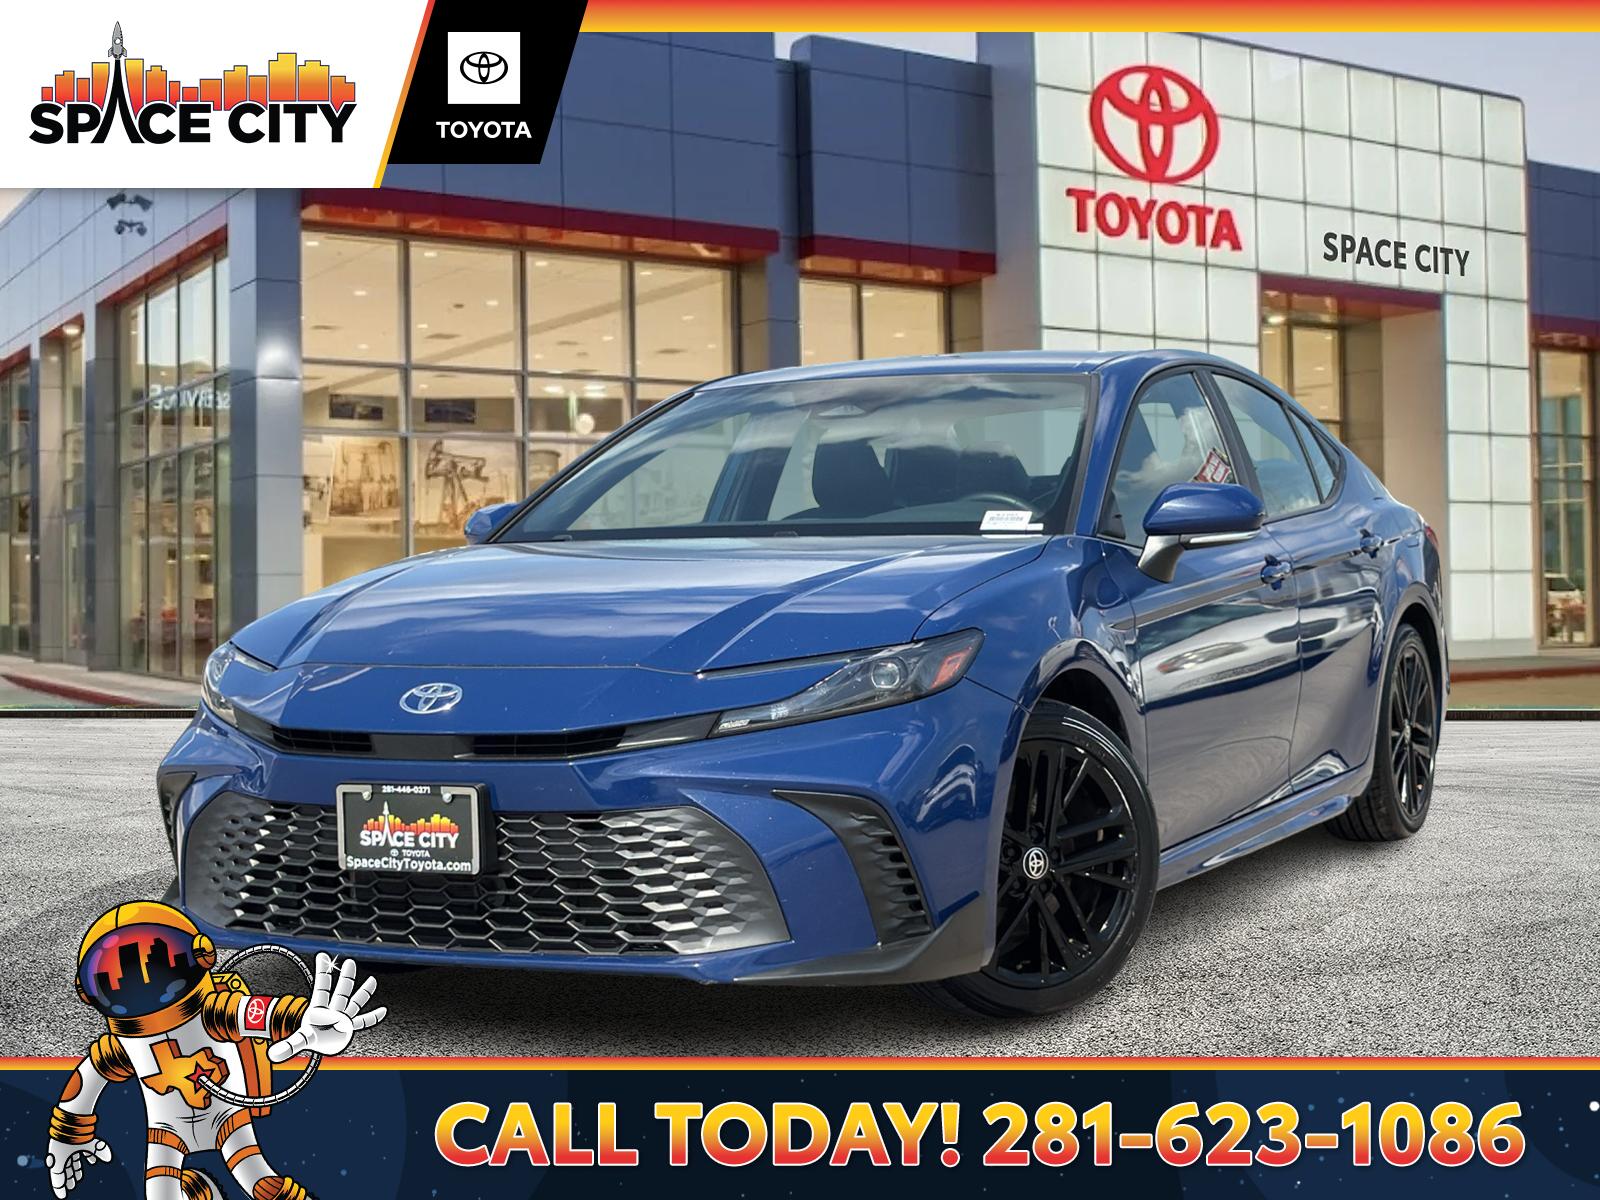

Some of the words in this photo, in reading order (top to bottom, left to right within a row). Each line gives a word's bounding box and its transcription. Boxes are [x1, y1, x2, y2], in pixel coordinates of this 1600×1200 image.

[1066, 187, 1243, 251] TOYOTA
[1323, 232, 1407, 270] SPACE
[1414, 244, 1470, 277] CITY
[419, 832, 459, 848] CITY
[402, 849, 430, 857] TOYOTA
[346, 855, 471, 872] SpaceCityToyota.com
